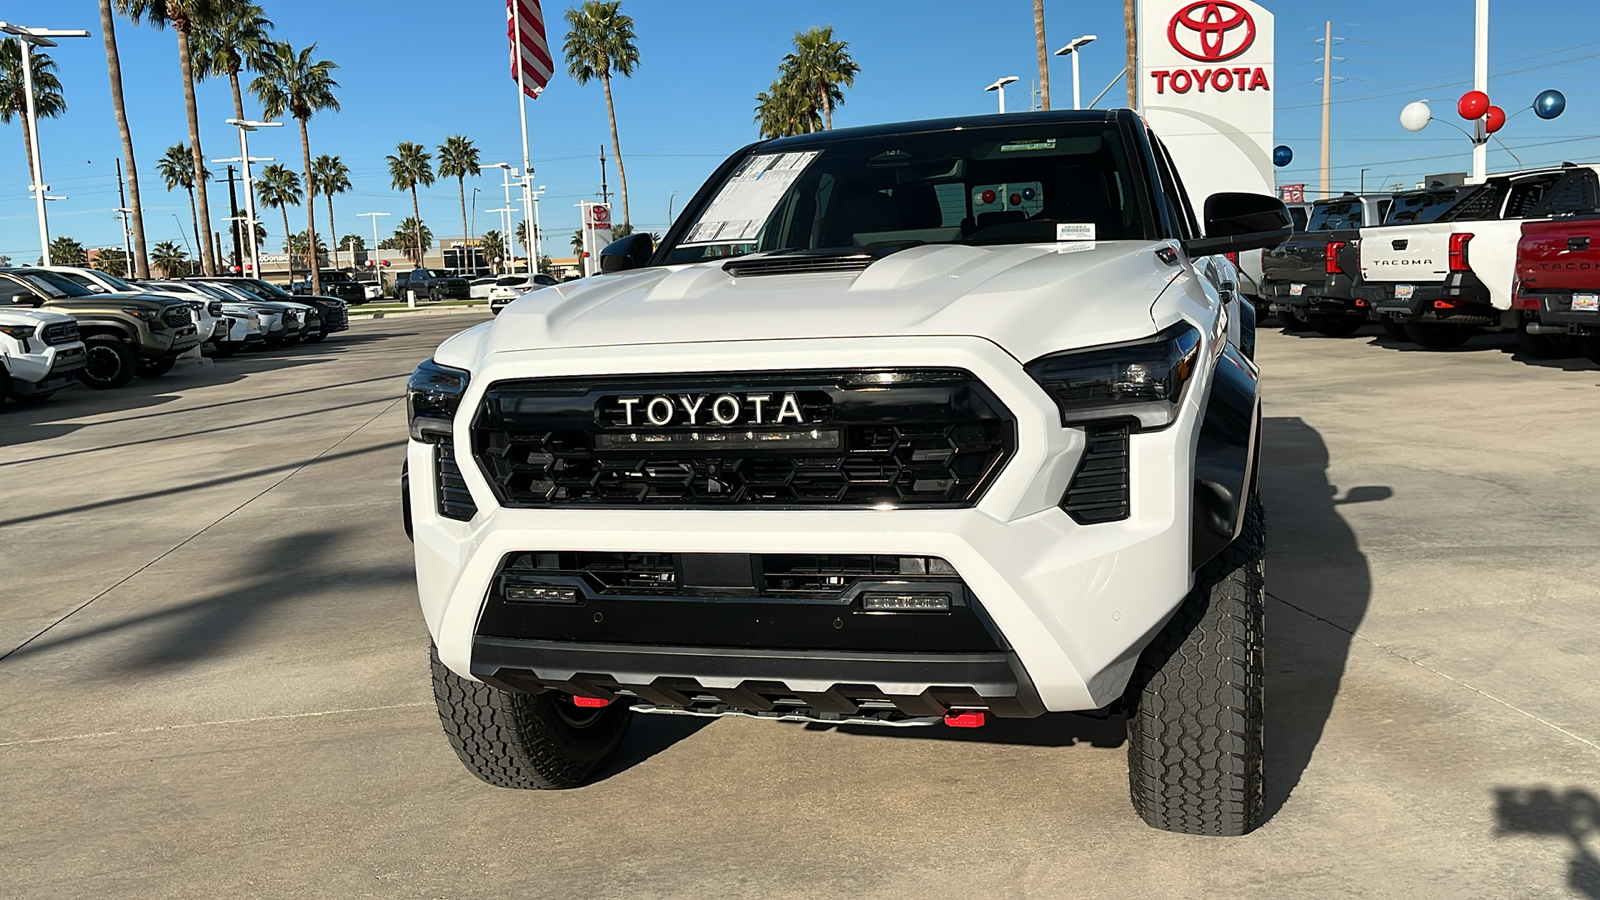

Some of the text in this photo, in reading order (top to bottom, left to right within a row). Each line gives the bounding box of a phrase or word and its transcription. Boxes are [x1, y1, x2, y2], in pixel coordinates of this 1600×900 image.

[1150, 67, 1270, 94] TOYOTA
[586, 222, 611, 230] TYOTA
[1372, 258, 1433, 266] TACOMA
[617, 392, 806, 426] TOYOTA
